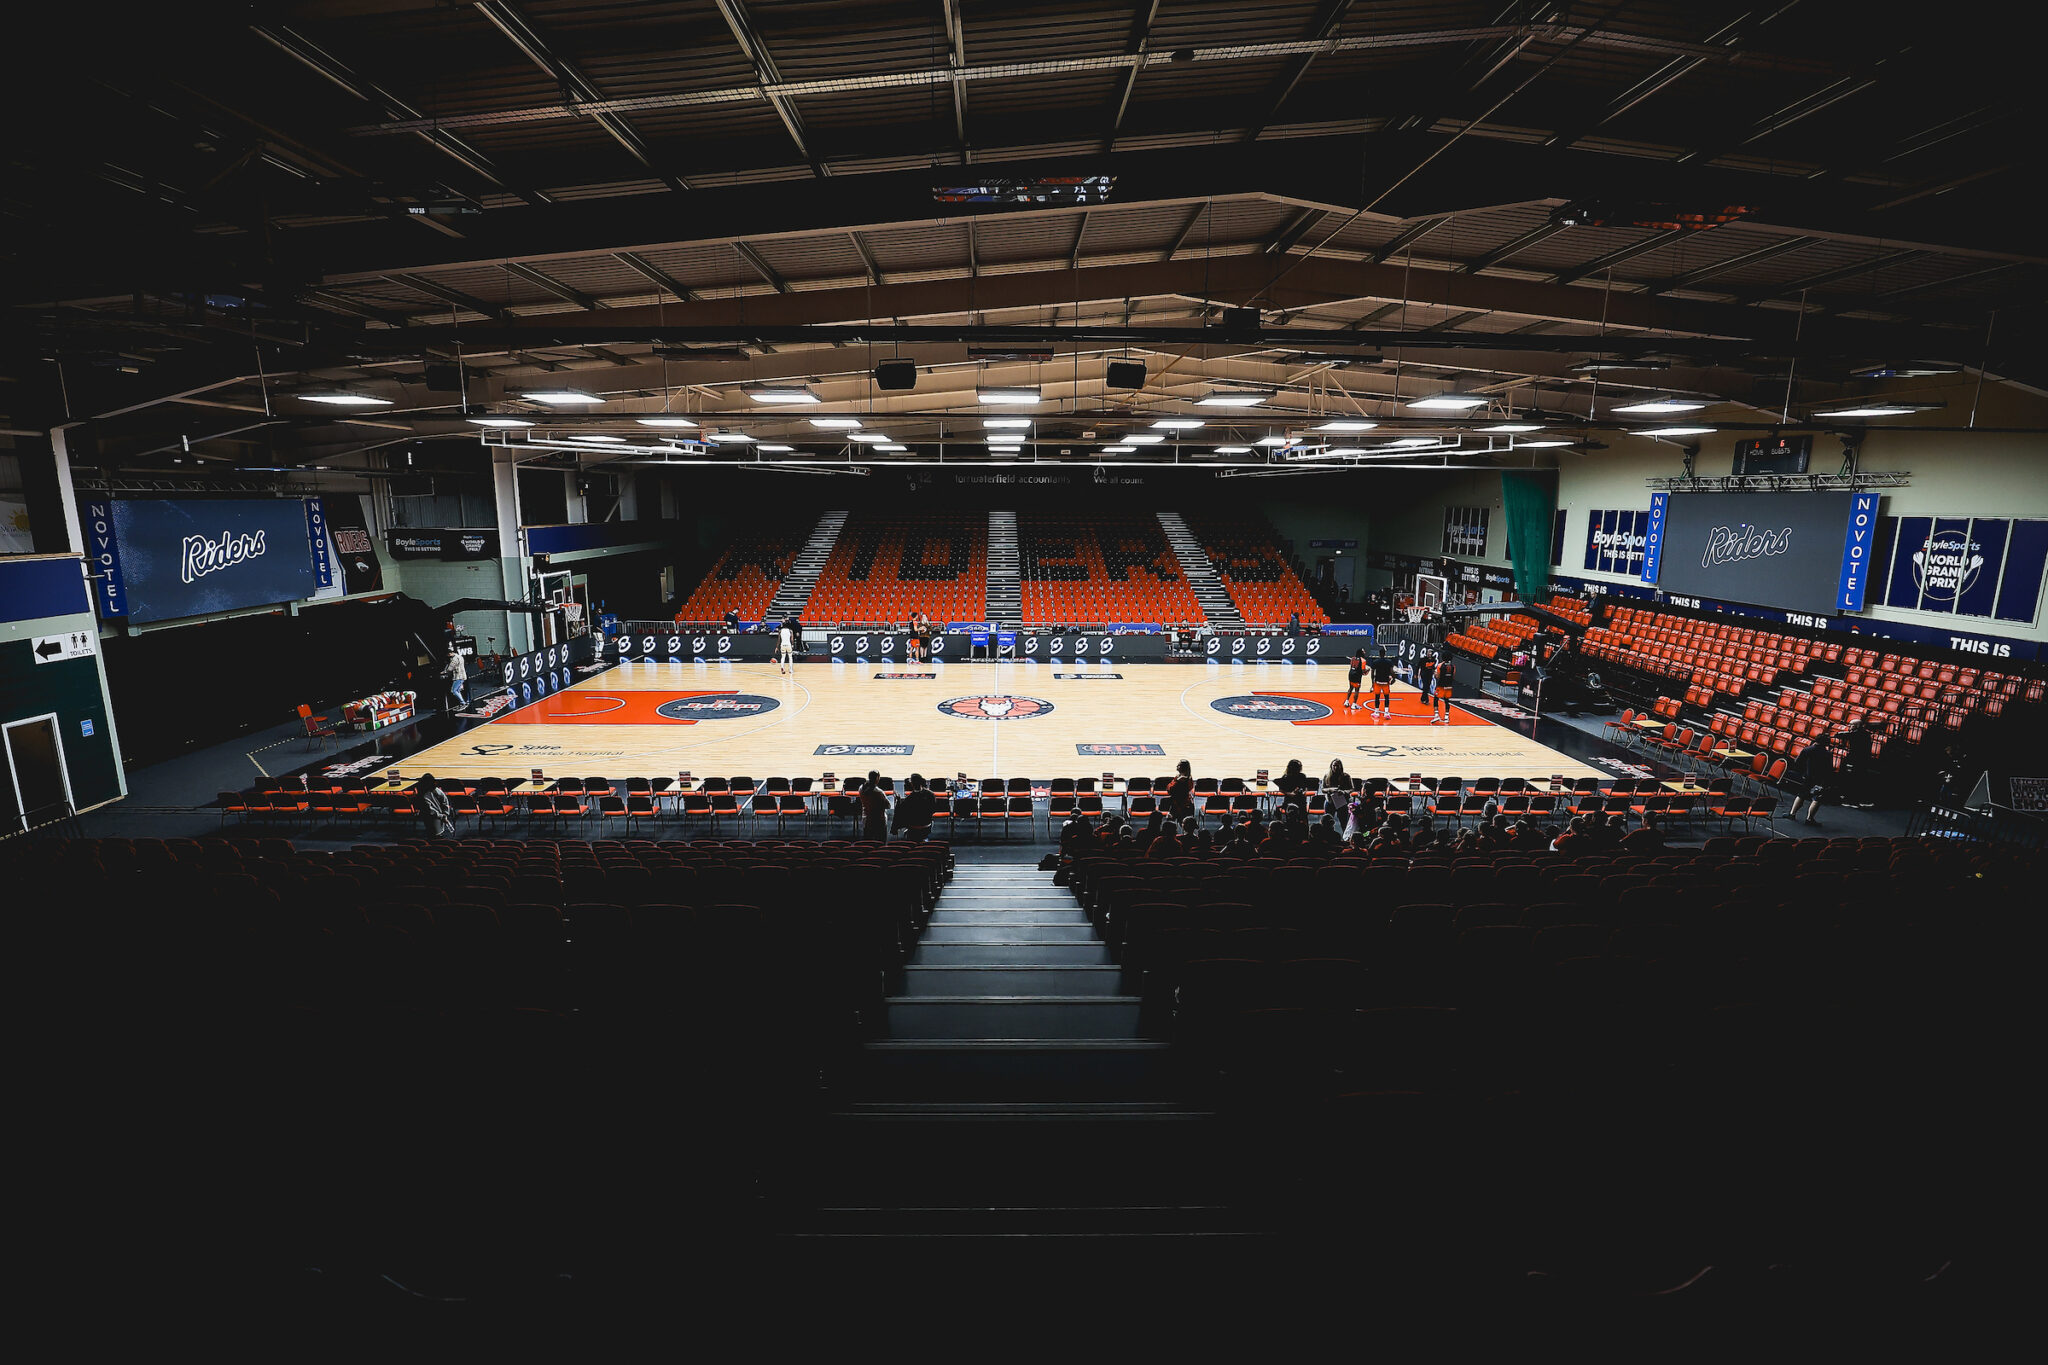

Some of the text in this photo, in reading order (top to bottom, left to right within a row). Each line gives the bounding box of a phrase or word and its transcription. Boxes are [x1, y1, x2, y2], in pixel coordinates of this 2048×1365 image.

[1093, 476, 1107, 484] We
[311, 502, 327, 585] NOVOTEL
[335, 530, 372, 554] RIDERS
[395, 538, 441, 547] BoyleSports
[1646, 496, 1663, 579] NOVOTEL
[1702, 525, 1792, 568] Riders
[1845, 498, 1871, 605] NOVOTEL
[1923, 540, 1981, 551] ByleSpots
[91, 504, 119, 613] NOVOTEL
[182, 530, 265, 583] Riders
[1603, 549, 1618, 558] THIS
[1618, 550, 1626, 559] IS
[1485, 573, 1510, 583] BoyleSports
[1929, 576, 1957, 589] PRIX
[1583, 583, 1600, 593] THIS
[1600, 586, 1607, 594] IS
[1670, 596, 1700, 609] THIS IS
[1785, 612, 1827, 630] THIS IS
[70, 648, 93, 657] TOILETS
[1950, 637, 2011, 658] THIS IS
[1092, 744, 1159, 752] RDL
